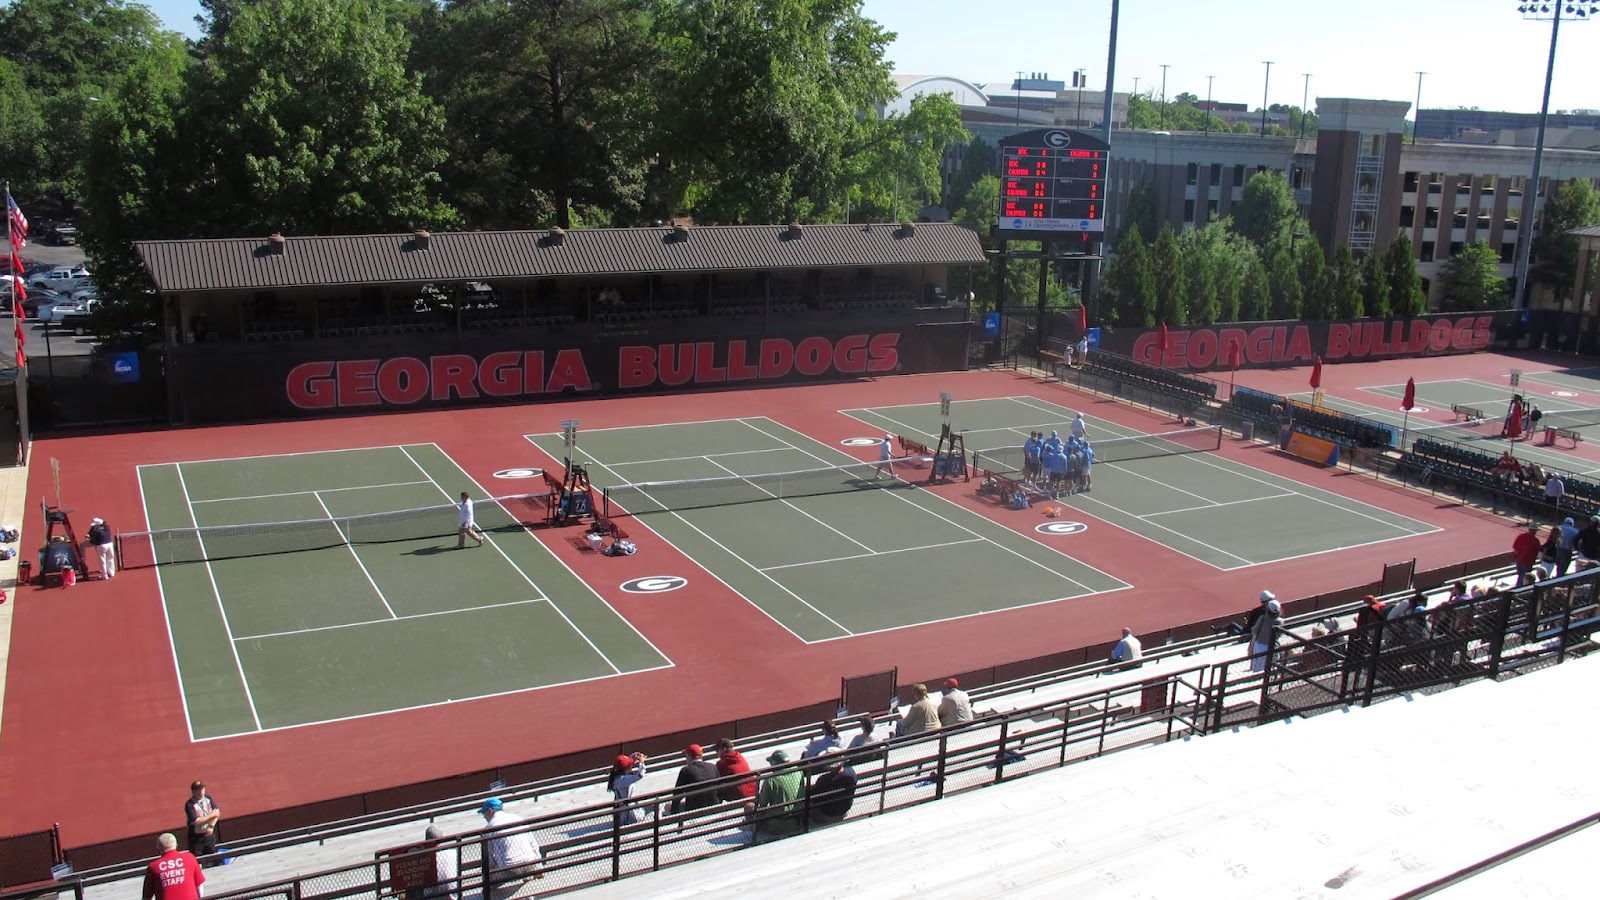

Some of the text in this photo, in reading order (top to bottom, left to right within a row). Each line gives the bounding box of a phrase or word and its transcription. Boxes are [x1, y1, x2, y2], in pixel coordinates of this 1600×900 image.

[1132, 316, 1493, 368] GEORGIA BULLDOGS
[286, 333, 900, 408] GEORGIA BULLDOGS
[158, 858, 184, 871] CSC
[160, 868, 186, 880] EVENT
[161, 876, 185, 887] STAFF
